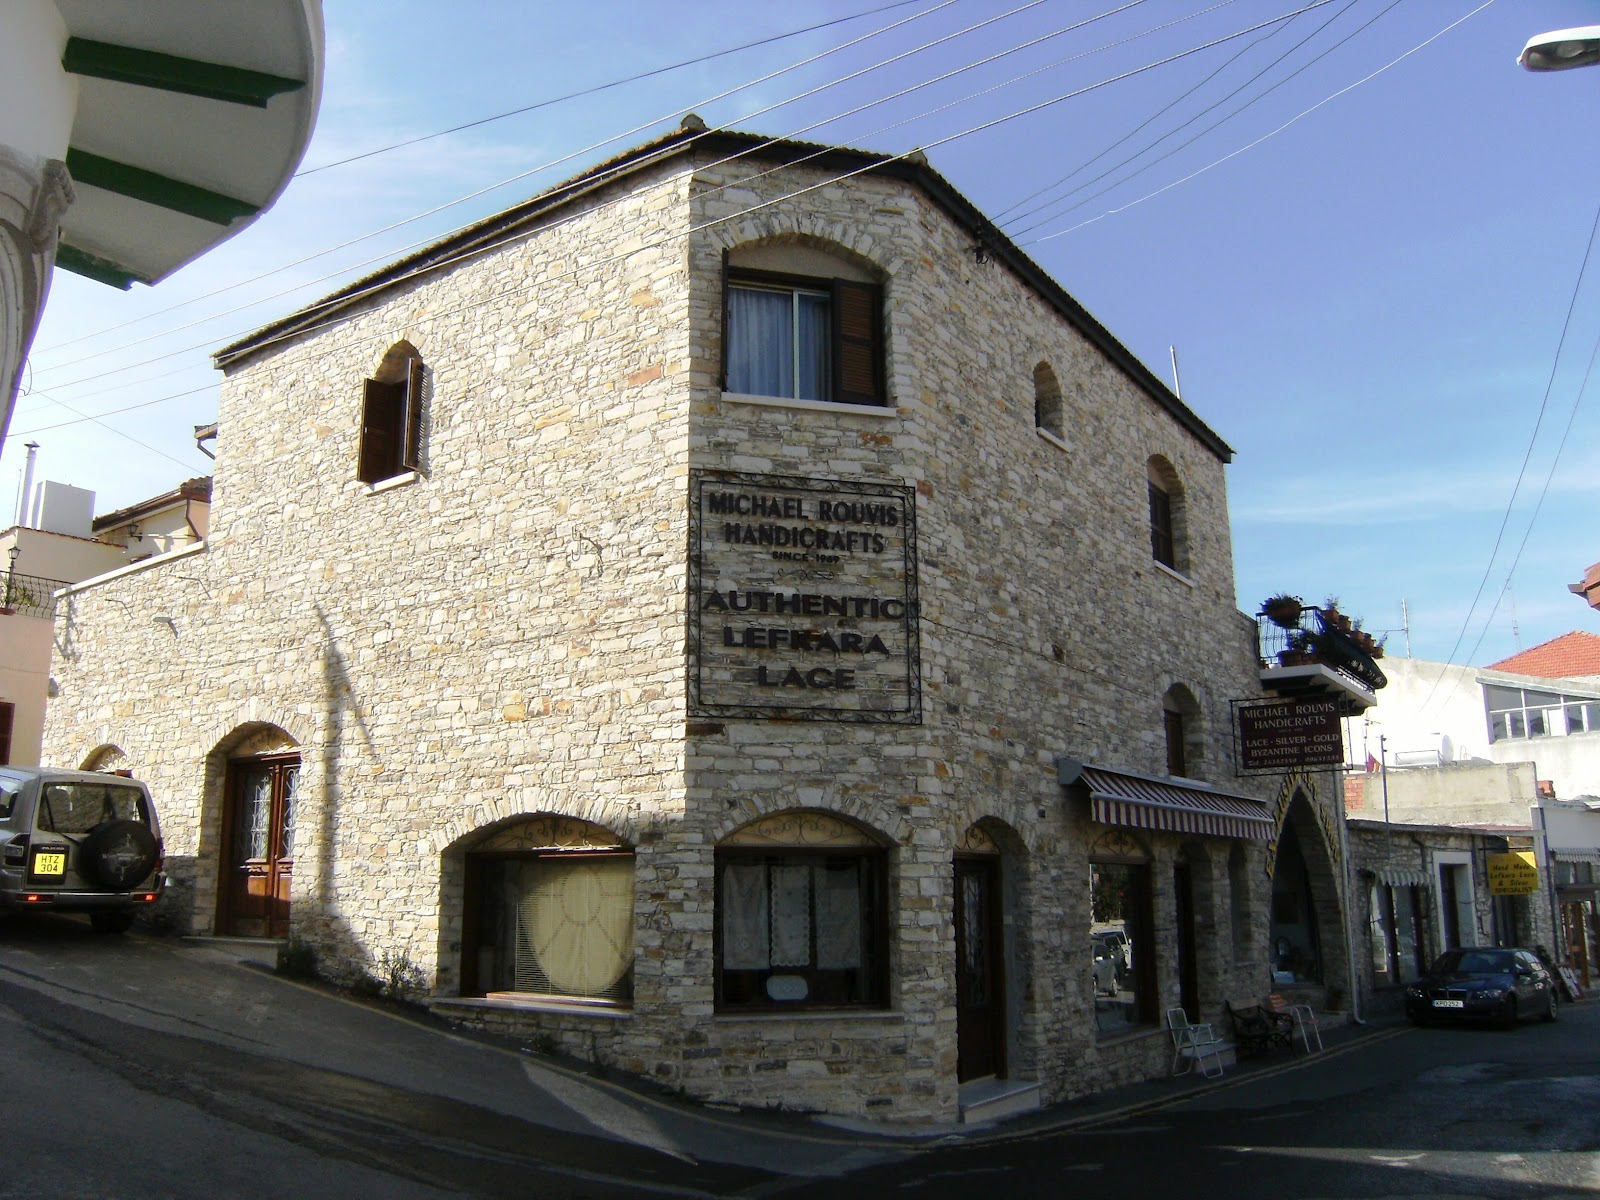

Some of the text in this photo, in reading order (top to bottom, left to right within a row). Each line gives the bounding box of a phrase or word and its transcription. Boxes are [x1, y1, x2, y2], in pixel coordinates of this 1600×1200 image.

[709, 492, 899, 527] MICHAEL ROUVIS
[725, 522, 884, 554] HANDICRAFTS
[772, 551, 840, 564] SINCE 1969
[702, 590, 906, 620] AUTHENTIC
[723, 626, 890, 656] LEFKARA
[758, 665, 856, 690] LACE
[1244, 702, 1335, 719] MICHAEL ROUVIS
[1254, 715, 1327, 729] HANDICRAFTS
[1246, 733, 1339, 748] LACE SILVER GOLD
[1251, 744, 1333, 757] BYZANTINE ICONS
[41, 855, 60, 864] HTZ
[1493, 863, 1509, 871] Hand
[40, 863, 59, 873] 304
